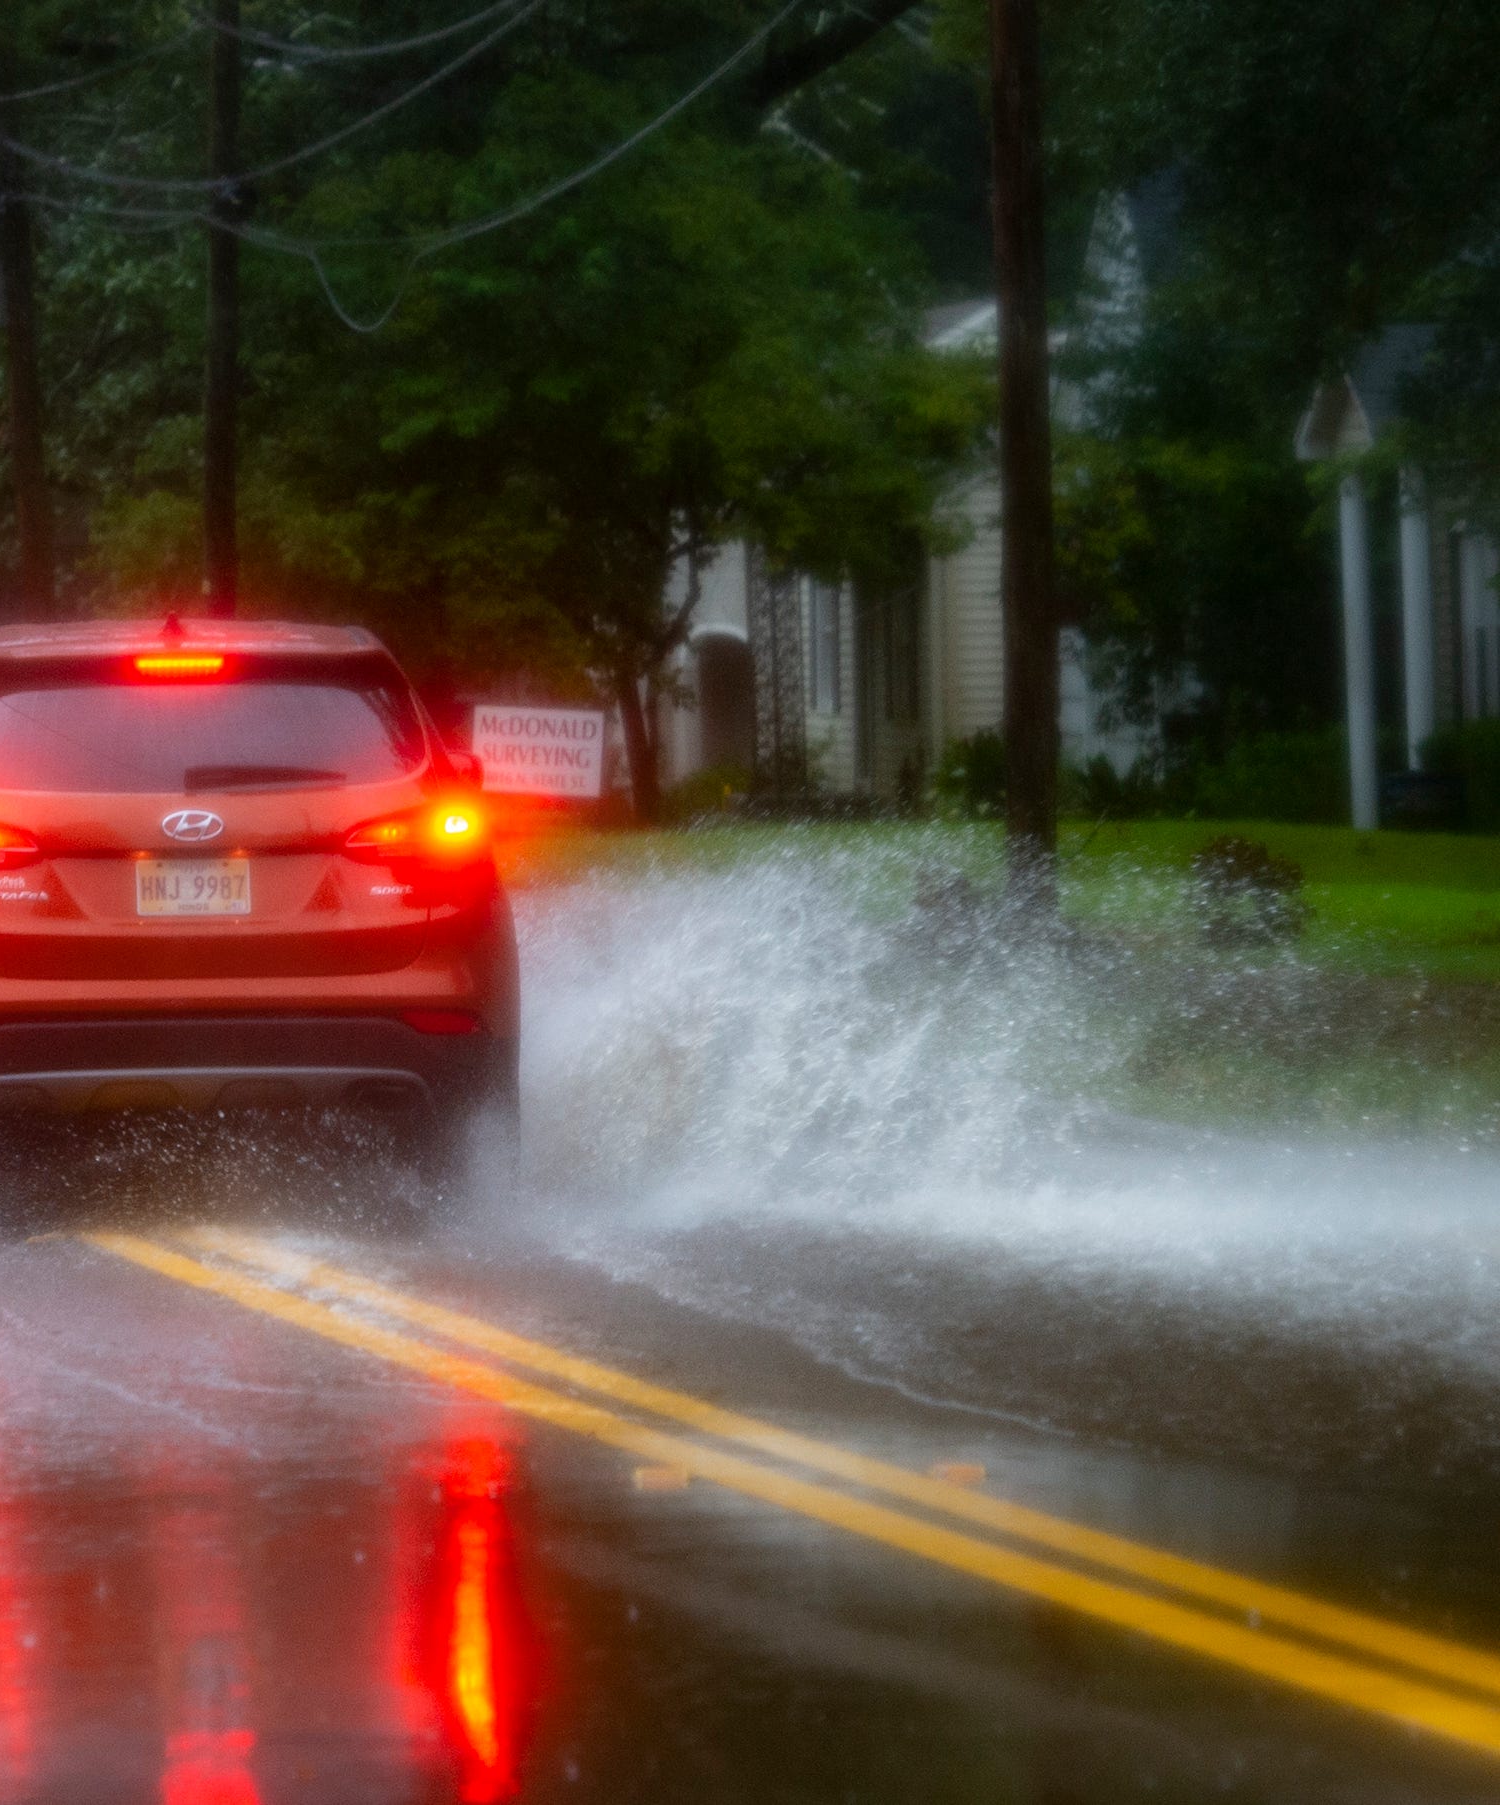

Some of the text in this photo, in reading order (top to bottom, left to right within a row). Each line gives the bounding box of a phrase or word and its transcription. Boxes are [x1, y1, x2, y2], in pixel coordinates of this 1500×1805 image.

[479, 714, 598, 740] McDONALD
[483, 743, 591, 769] SURVEYING
[141, 875, 245, 900] HNJ 9987
